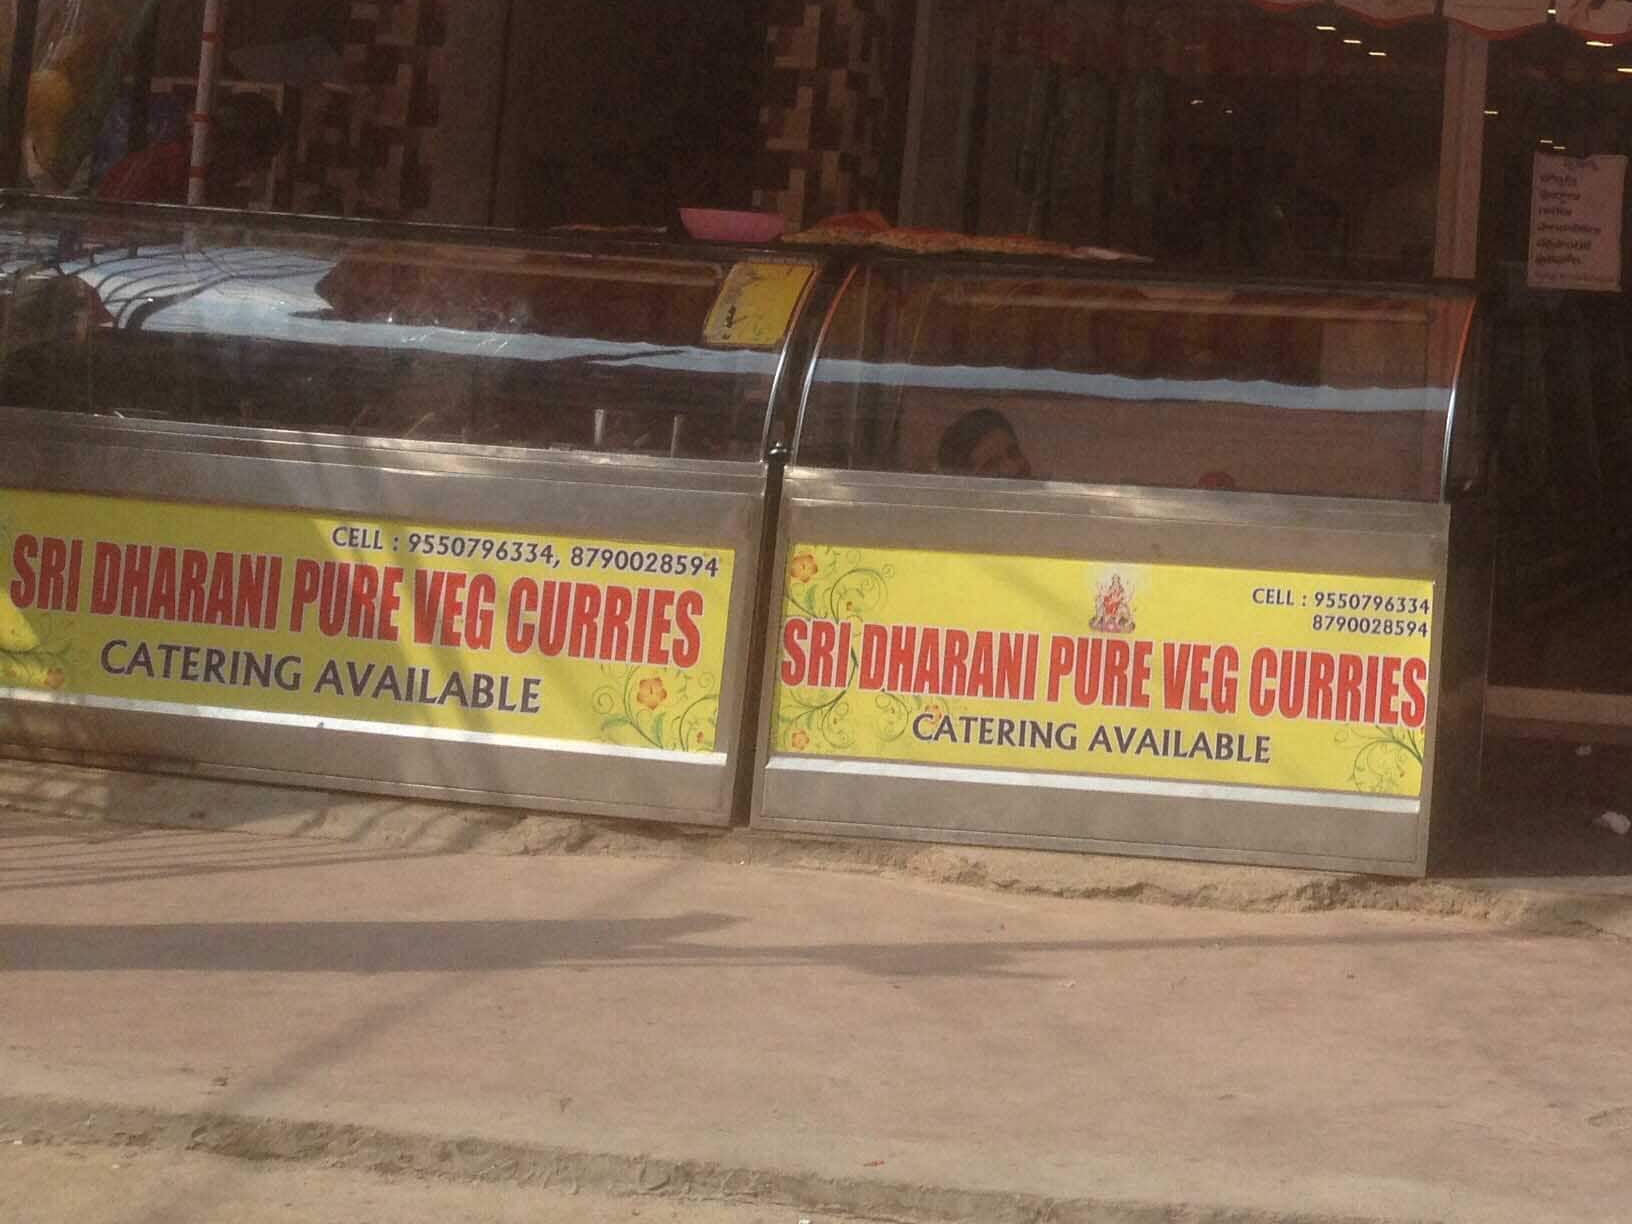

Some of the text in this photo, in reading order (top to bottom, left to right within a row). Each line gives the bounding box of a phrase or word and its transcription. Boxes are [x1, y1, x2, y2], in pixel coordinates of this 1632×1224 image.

[331, 527, 383, 550] CELL
[408, 533, 560, 568] 9550796334,
[570, 546, 719, 577] 8790028594
[10, 533, 704, 667] SRI DHARANI PURE VEG CURRIES
[1252, 588, 1294, 606] CELL
[1314, 592, 1430, 615] 9550796334
[1312, 614, 1428, 637] 8790028594
[101, 640, 542, 714] CATERING AVAILABLE
[780, 618, 1428, 728] SRI DHARANI PURE VEG CURRIES
[912, 714, 1271, 763] CATERING AVAILABLE
